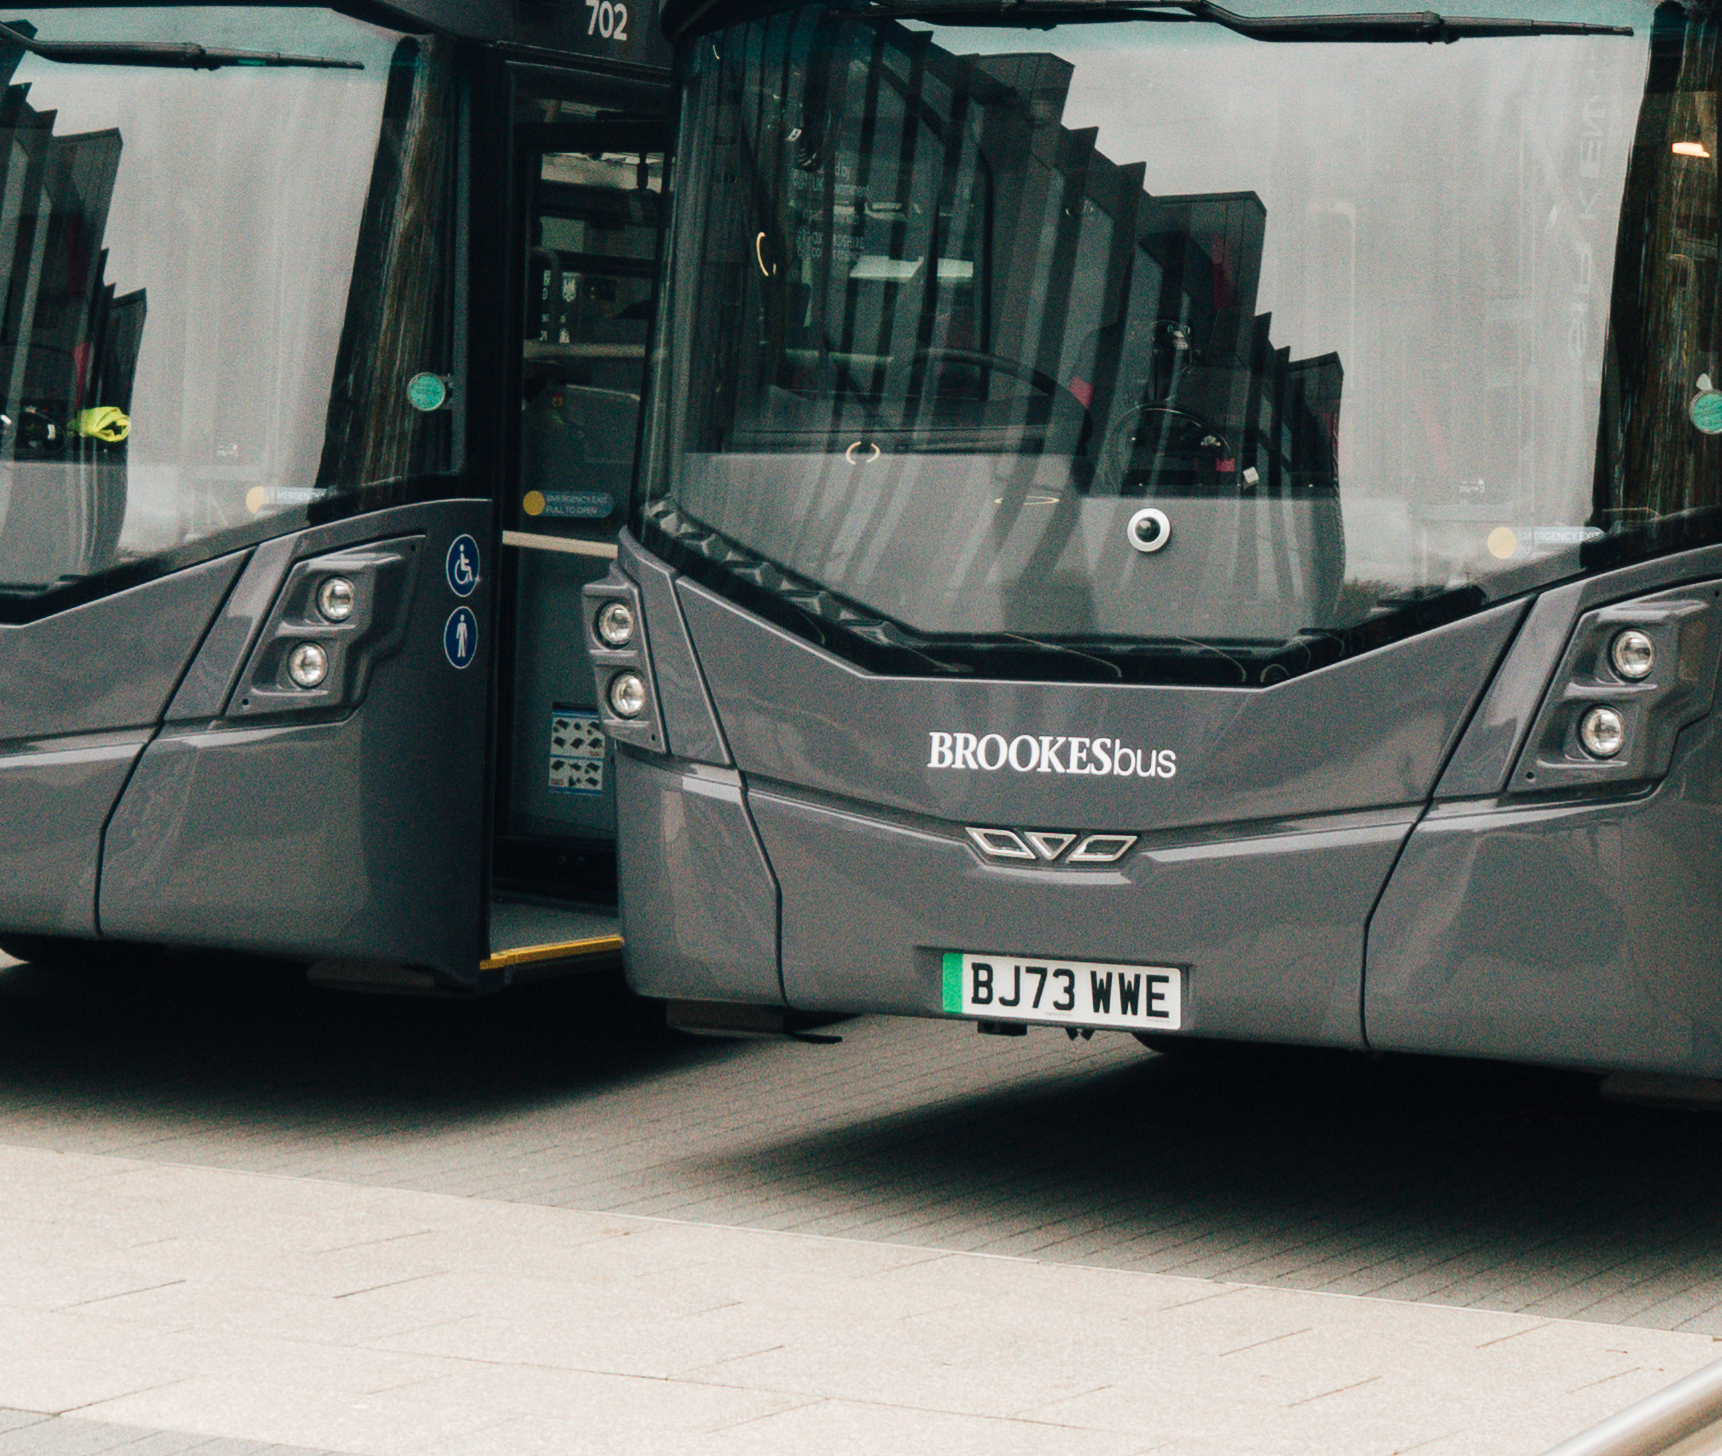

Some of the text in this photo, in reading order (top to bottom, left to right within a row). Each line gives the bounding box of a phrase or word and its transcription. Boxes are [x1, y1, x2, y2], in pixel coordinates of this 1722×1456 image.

[927, 732, 1177, 778] BROOKESbus
[971, 962, 1170, 1018] BJ73 WWE
